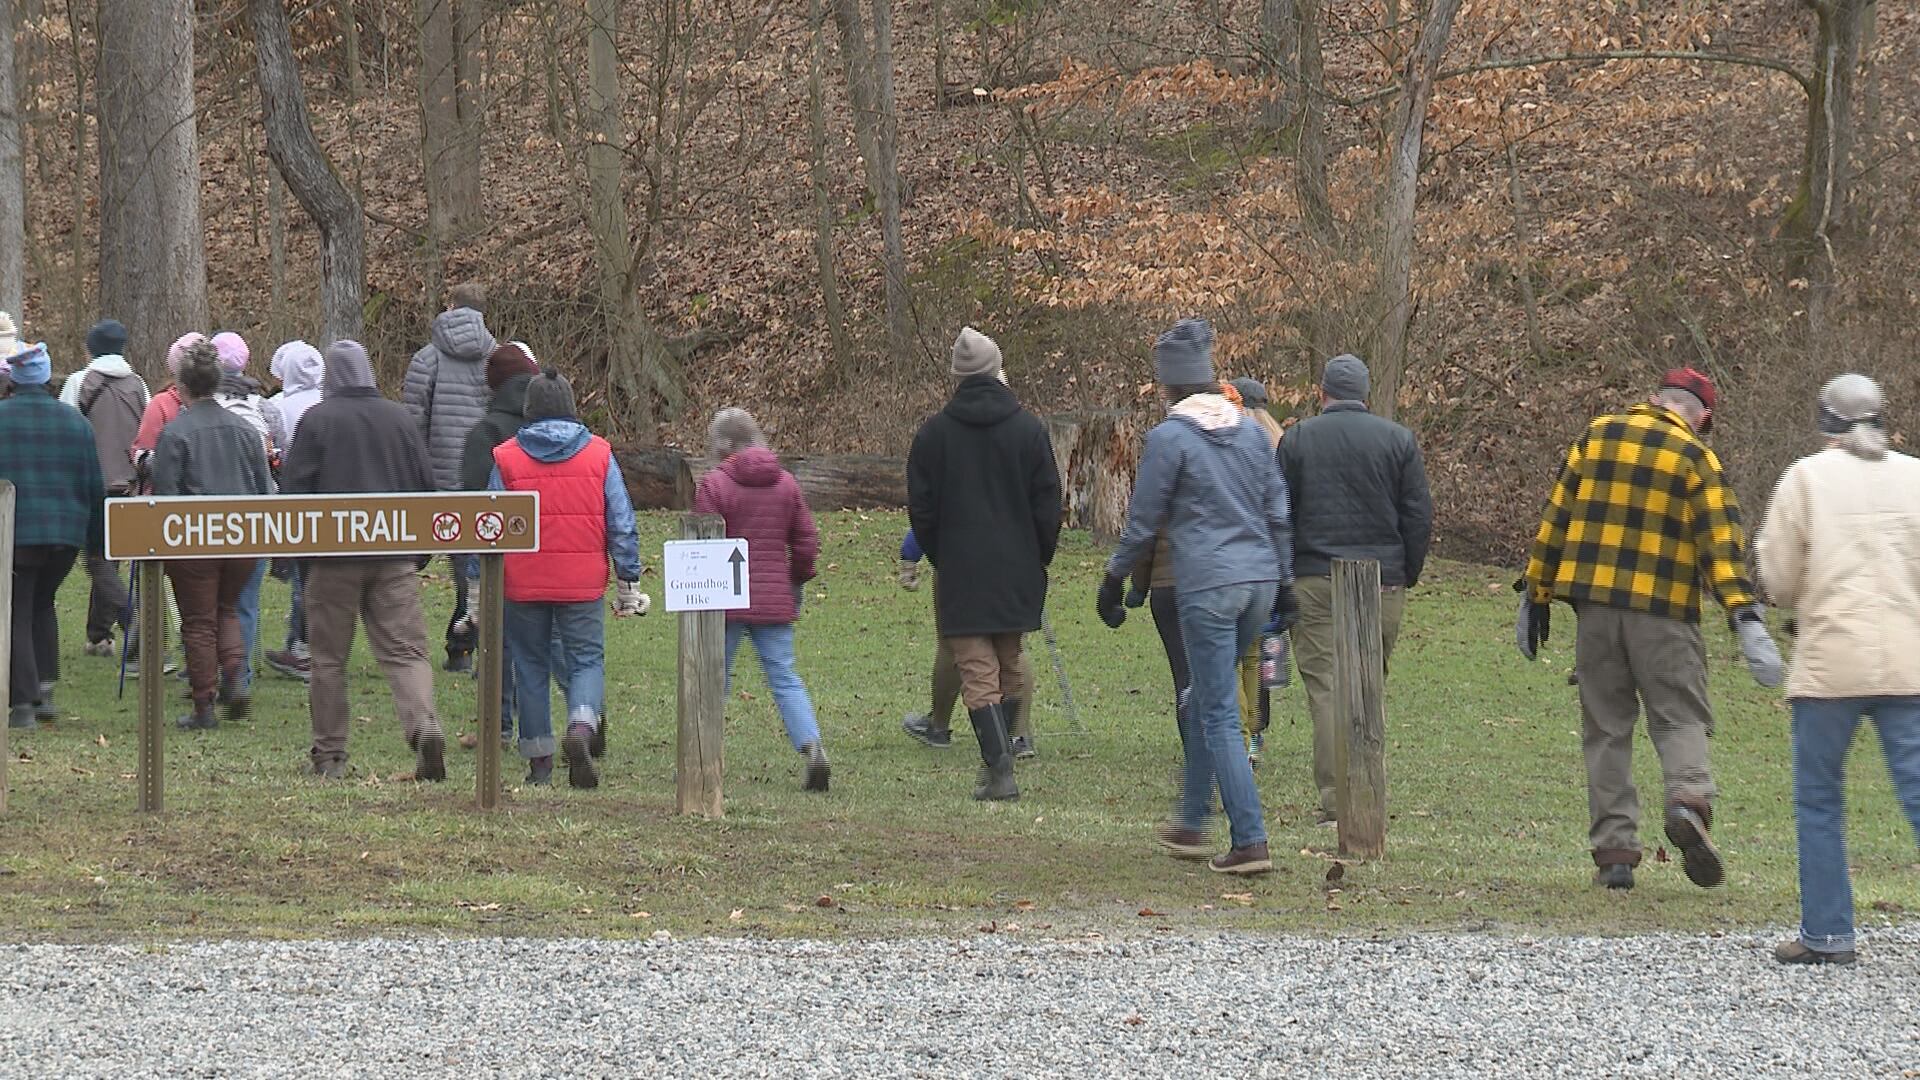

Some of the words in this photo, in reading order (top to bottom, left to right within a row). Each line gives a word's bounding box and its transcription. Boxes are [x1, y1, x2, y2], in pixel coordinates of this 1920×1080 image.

[163, 511, 323, 547] CHESTNUT
[332, 510, 416, 543] TRAIL
[670, 578, 728, 590] Groundhog
[686, 594, 709, 605] Hike
